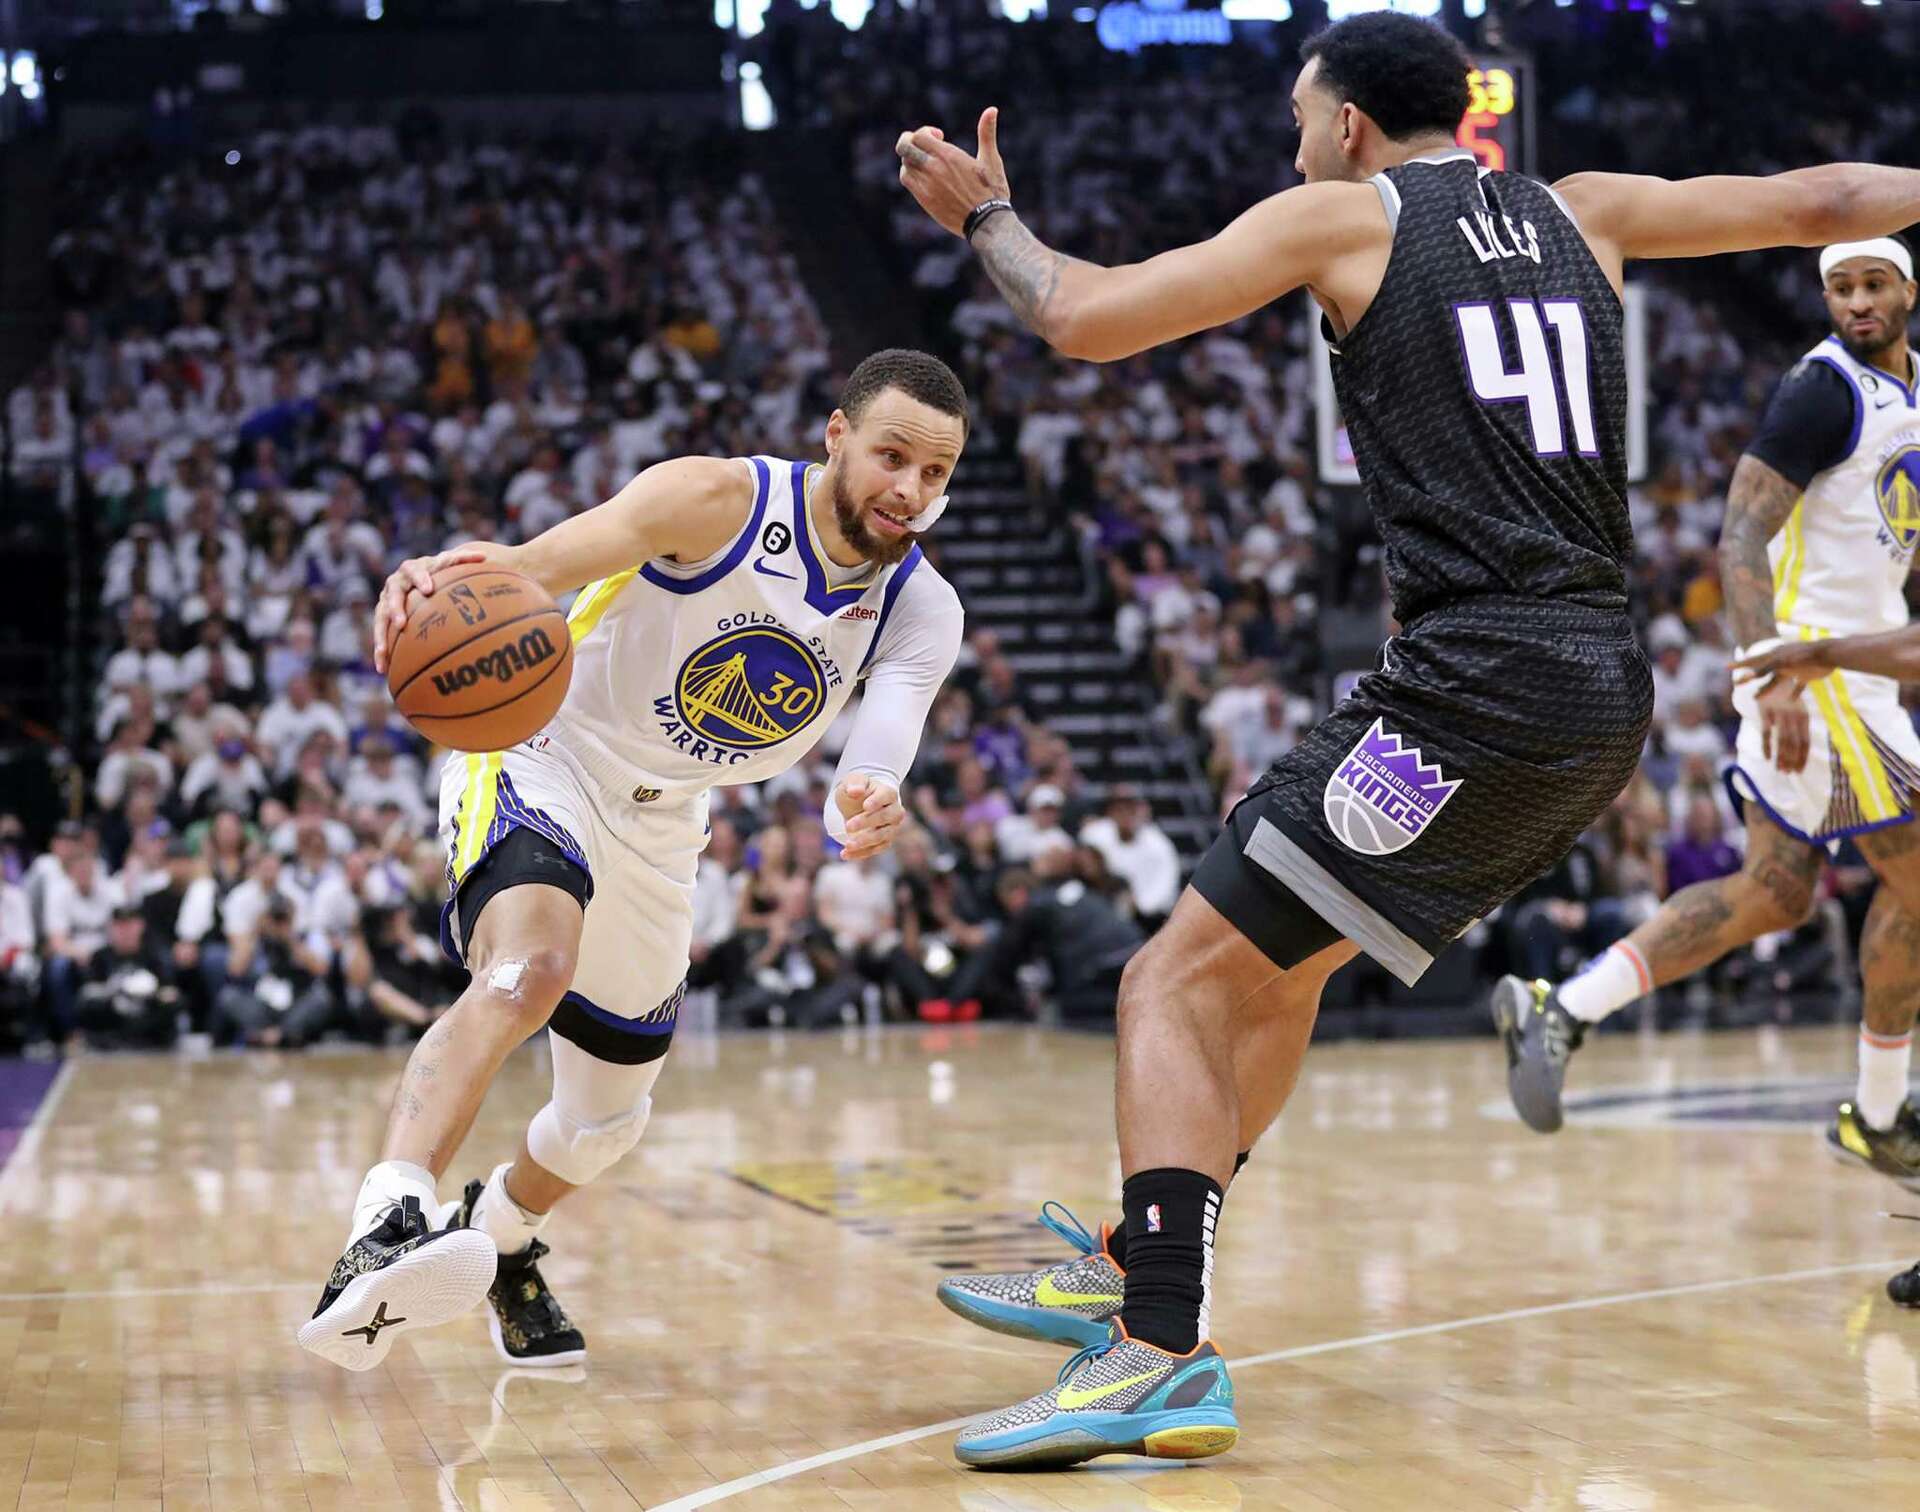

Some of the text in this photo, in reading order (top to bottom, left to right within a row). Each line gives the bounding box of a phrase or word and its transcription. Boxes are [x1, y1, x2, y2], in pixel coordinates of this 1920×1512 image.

[1452, 297, 1600, 457] 41
[765, 525, 787, 552] 6
[843, 606, 878, 621] uten
[432, 628, 555, 696] Wilson
[717, 611, 843, 688] GOLD STATE
[758, 671, 814, 715] 30
[1338, 760, 1427, 835] KINGS
[1357, 750, 1434, 812] SACRAMENTO
